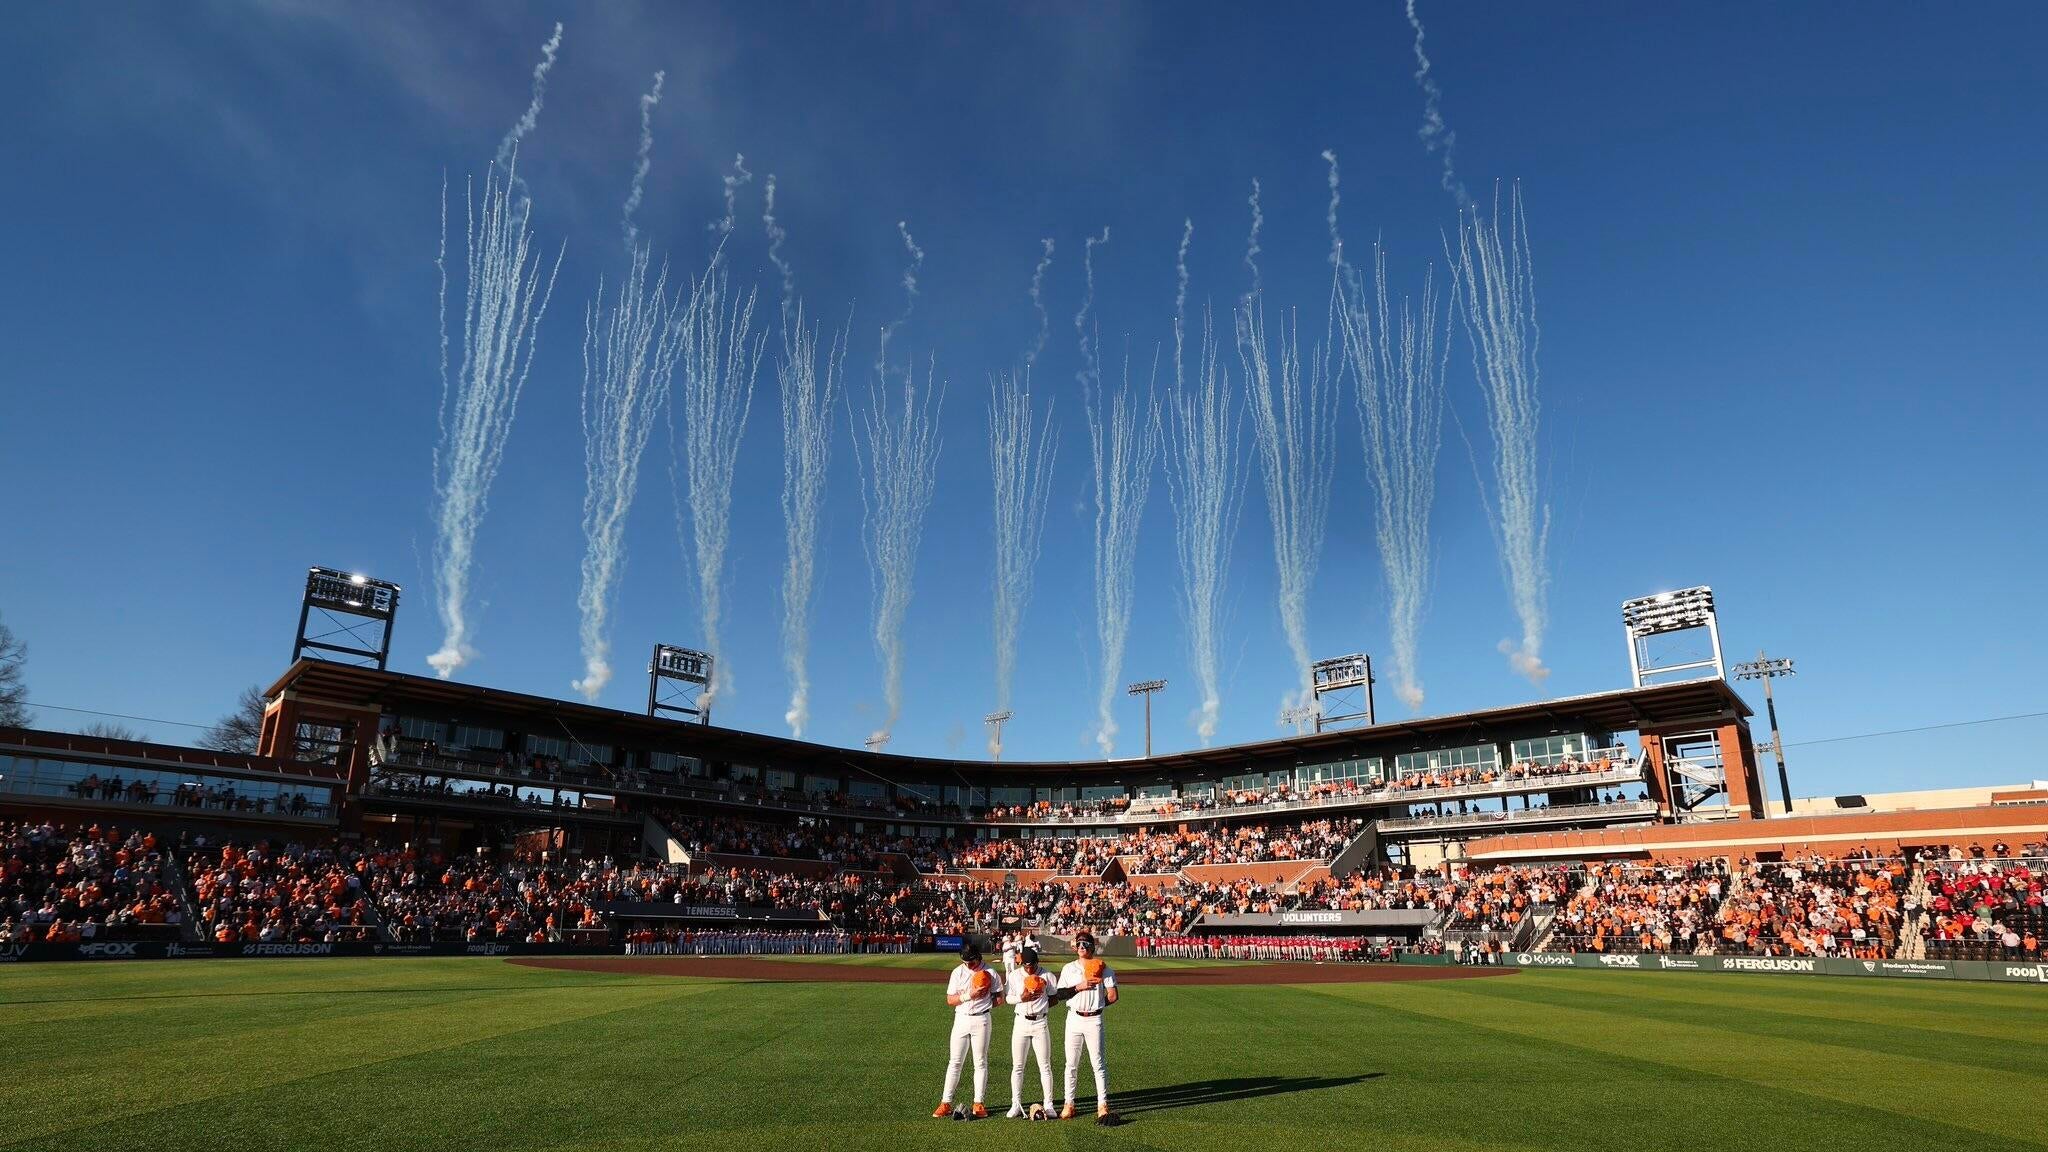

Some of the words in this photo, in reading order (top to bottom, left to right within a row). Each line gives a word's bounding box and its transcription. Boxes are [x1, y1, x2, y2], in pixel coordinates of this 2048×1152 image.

[686, 906, 737, 916] TENNESSEE
[1282, 912, 1342, 922] VOLUNTEERS
[89, 943, 138, 955] FOX
[256, 944, 331, 954] FERGUSON
[467, 945, 485, 953] FOOD
[1533, 954, 1575, 965] Kubota
[1608, 955, 1640, 965] FOX
[1735, 958, 1814, 971] FERGUSON
[2006, 967, 2038, 977] FOOD
